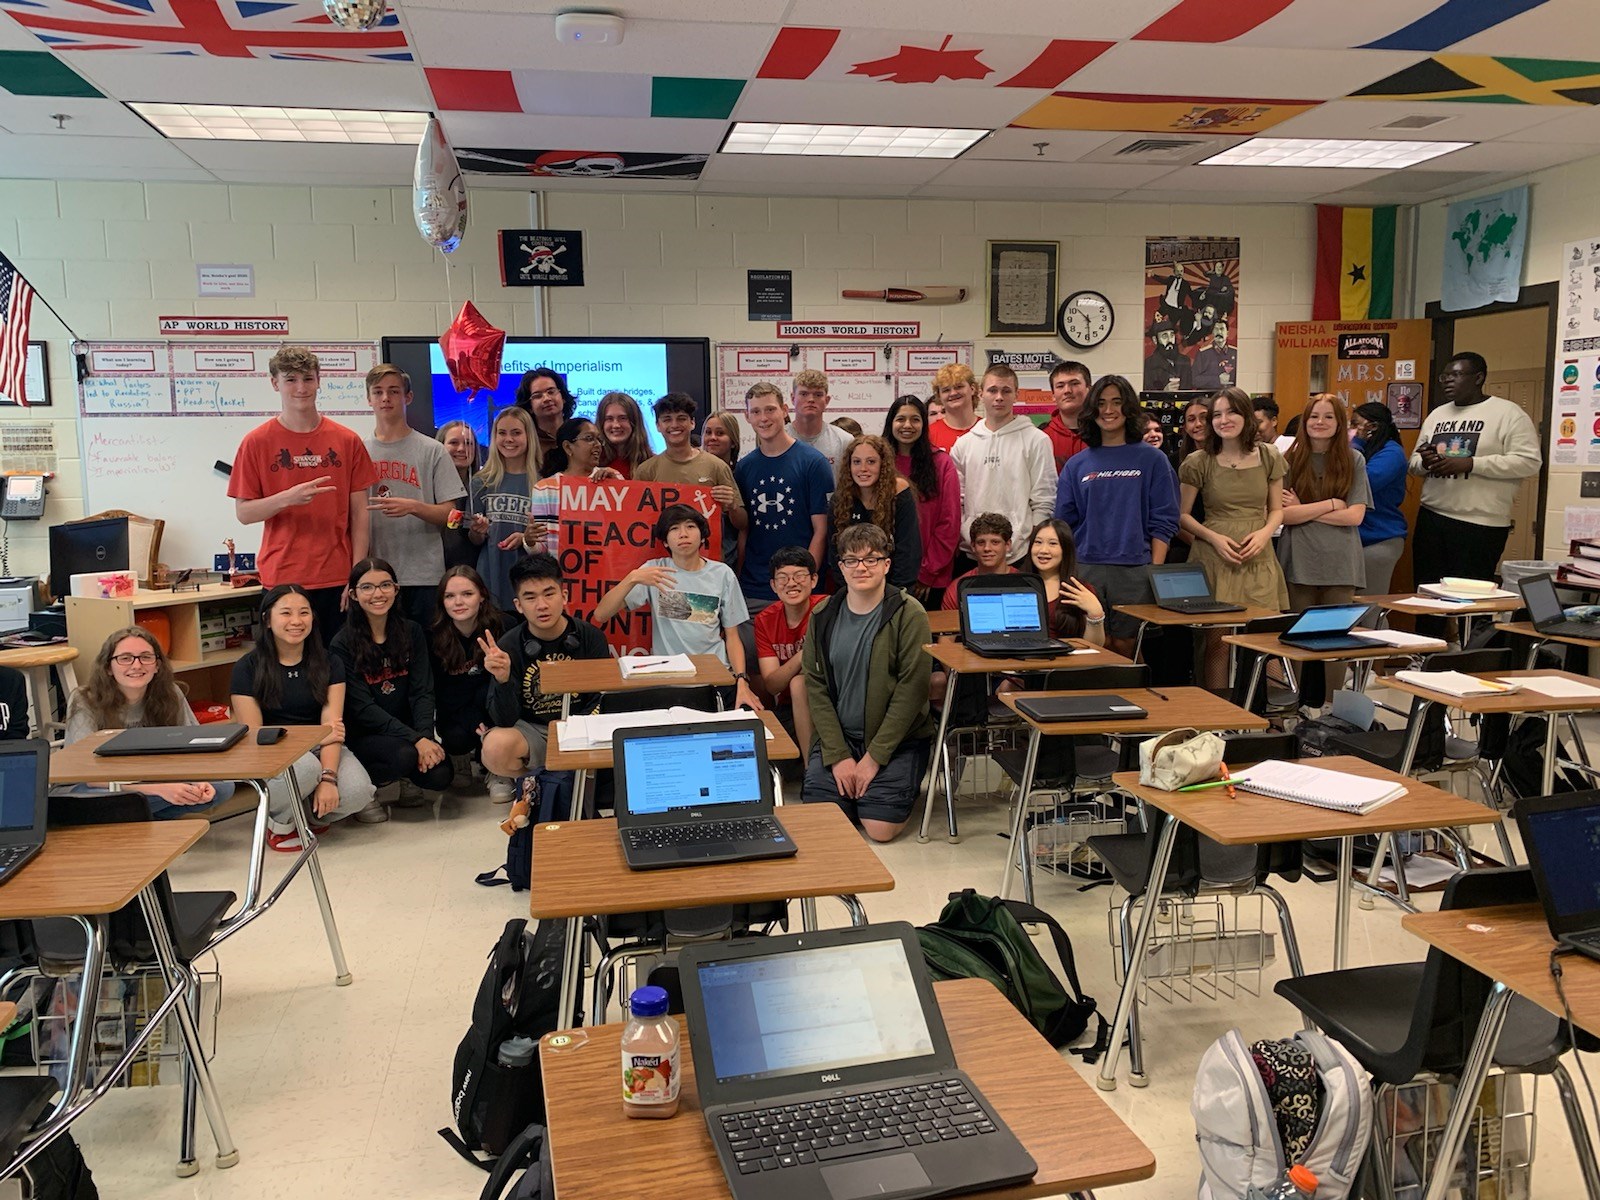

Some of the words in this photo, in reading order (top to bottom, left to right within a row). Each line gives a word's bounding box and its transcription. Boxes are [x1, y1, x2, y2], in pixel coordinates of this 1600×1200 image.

[164, 321, 179, 329] AP
[186, 321, 229, 330] WORLD
[234, 321, 286, 330] HISTORY
[784, 326, 826, 334] HONORS
[832, 326, 867, 334] WORLD
[873, 326, 916, 335] HISTORY
[1279, 325, 1326, 335] NEISHA
[1278, 337, 1338, 348] WILLIAMS
[1343, 337, 1384, 350] ALLATOONA
[992, 354, 1023, 364] BATES
[1023, 354, 1055, 363] MOTEL
[500, 360, 531, 372] efits
[534, 360, 547, 372] of
[550, 360, 623, 374] Imperialism
[1338, 363, 1391, 382] MRS.
[577, 387, 595, 396] Built
[623, 387, 656, 397] bridges,
[1161, 414, 1172, 424] 02
[1433, 420, 1458, 434] RICK
[1459, 420, 1485, 432] AND
[374, 460, 421, 487] RGIA
[1097, 469, 1142, 478] HILFIGER
[482, 495, 531, 513] IGER
[561, 485, 629, 511] MAY
[637, 487, 680, 512] AP
[559, 549, 603, 574] OF
[633, 1057, 660, 1067] Naked
[463, 1069, 473, 1091] new
[821, 1073, 841, 1083] DELL
